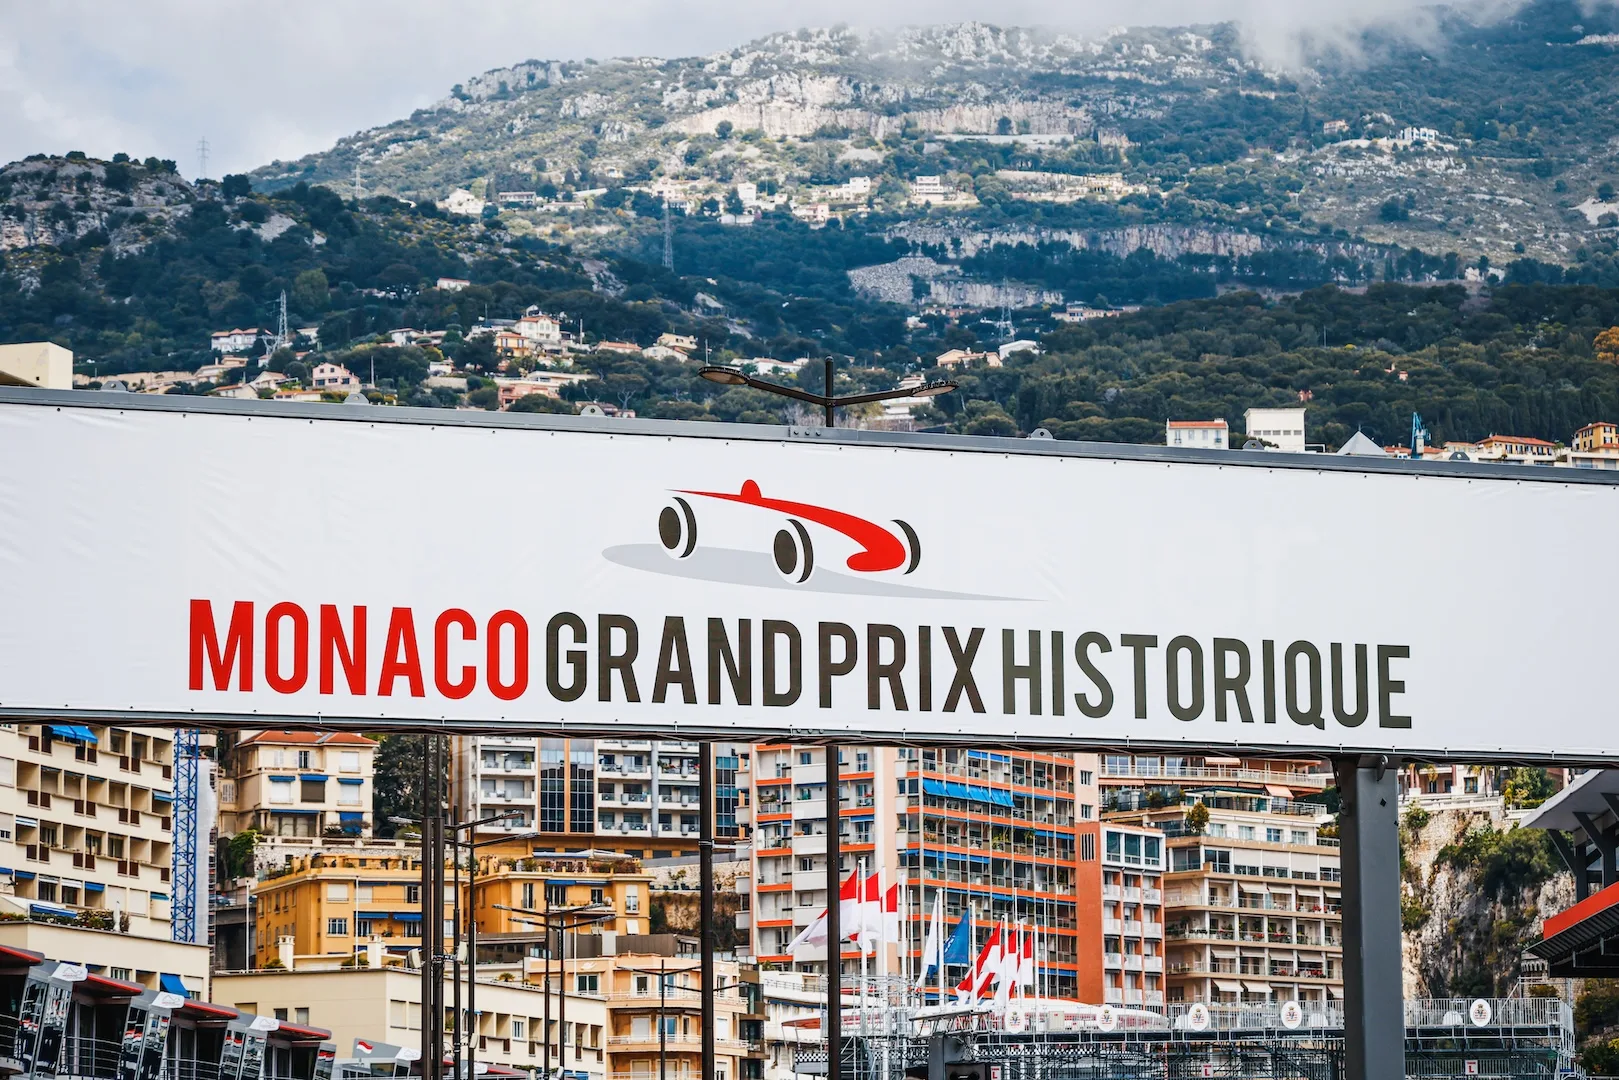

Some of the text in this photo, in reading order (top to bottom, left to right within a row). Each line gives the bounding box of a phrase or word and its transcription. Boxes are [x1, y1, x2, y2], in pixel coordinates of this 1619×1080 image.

[188, 598, 1413, 731] MONACO GRAND PRIX HISTORIQUE
